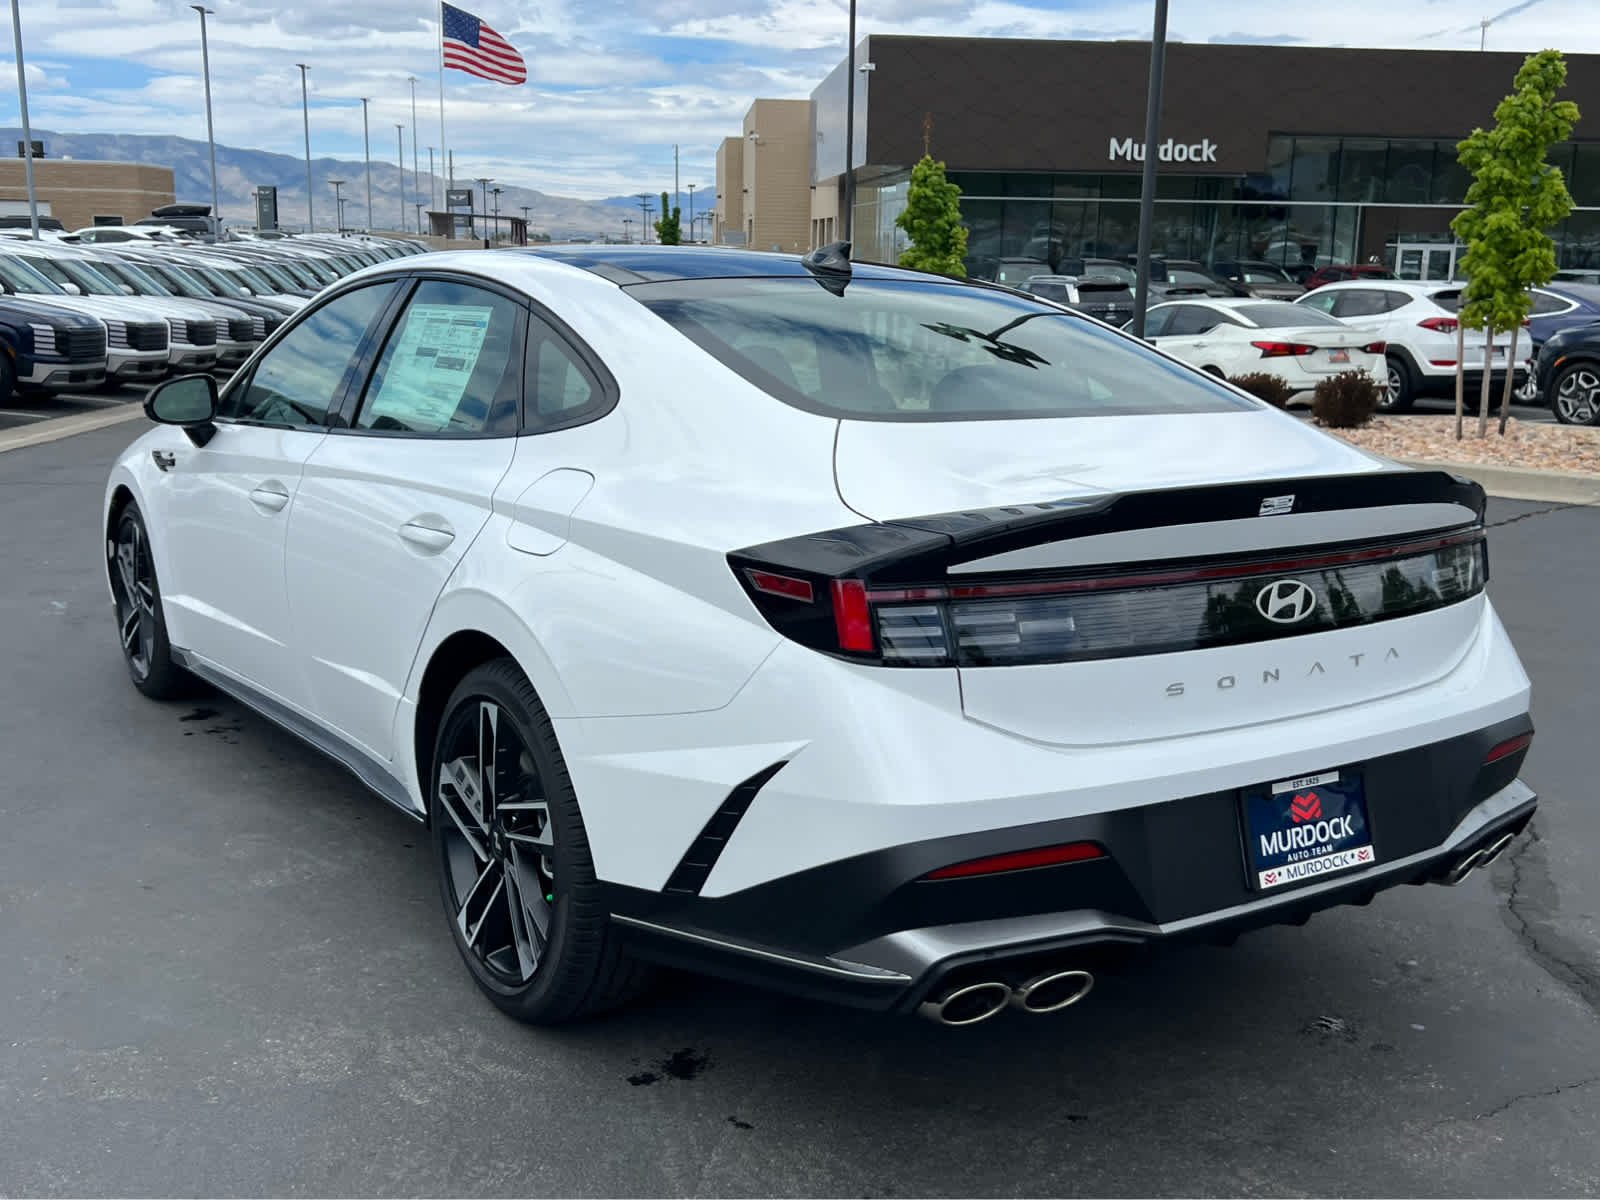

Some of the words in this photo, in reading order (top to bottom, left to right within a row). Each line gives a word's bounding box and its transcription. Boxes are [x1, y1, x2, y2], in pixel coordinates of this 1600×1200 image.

[1109, 137, 1217, 162] Mudock
[1166, 647, 1400, 696] SONATA
[1260, 815, 1354, 856] MURDOCK
[1287, 852, 1309, 862] AUTO
[1311, 844, 1333, 855] TEAM
[1286, 855, 1349, 879] MURDOCK
